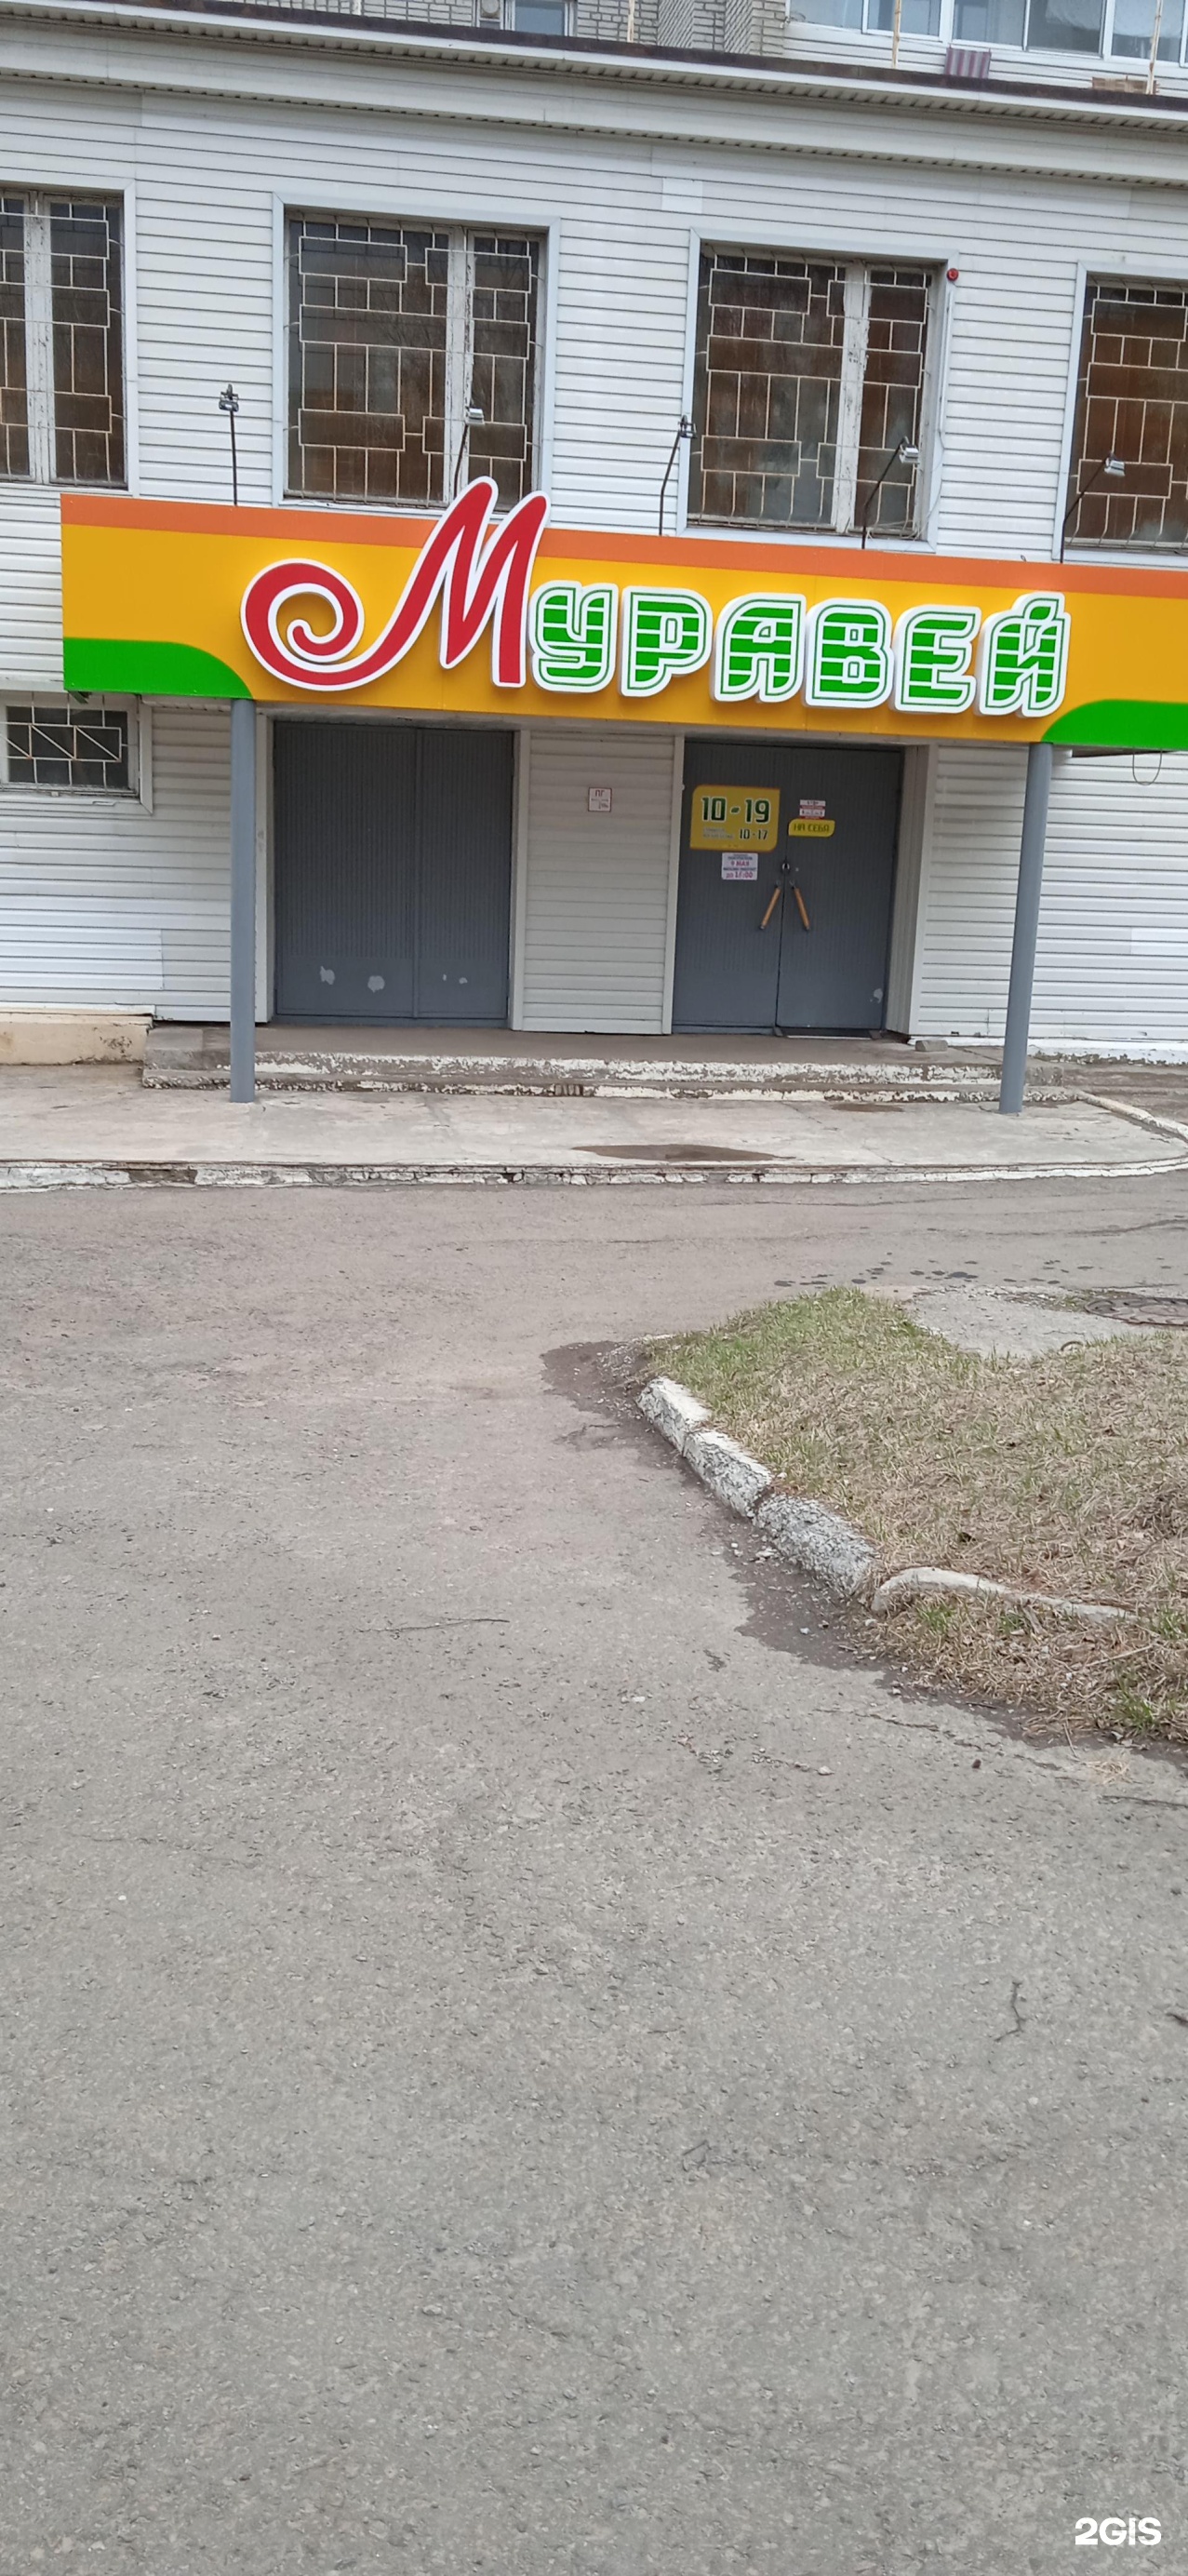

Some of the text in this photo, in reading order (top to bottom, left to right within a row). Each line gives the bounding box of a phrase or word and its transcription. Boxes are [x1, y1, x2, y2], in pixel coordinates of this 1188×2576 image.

[594, 789, 606, 798] ПГ
[794, 823, 830, 833] НА СЕБЯ
